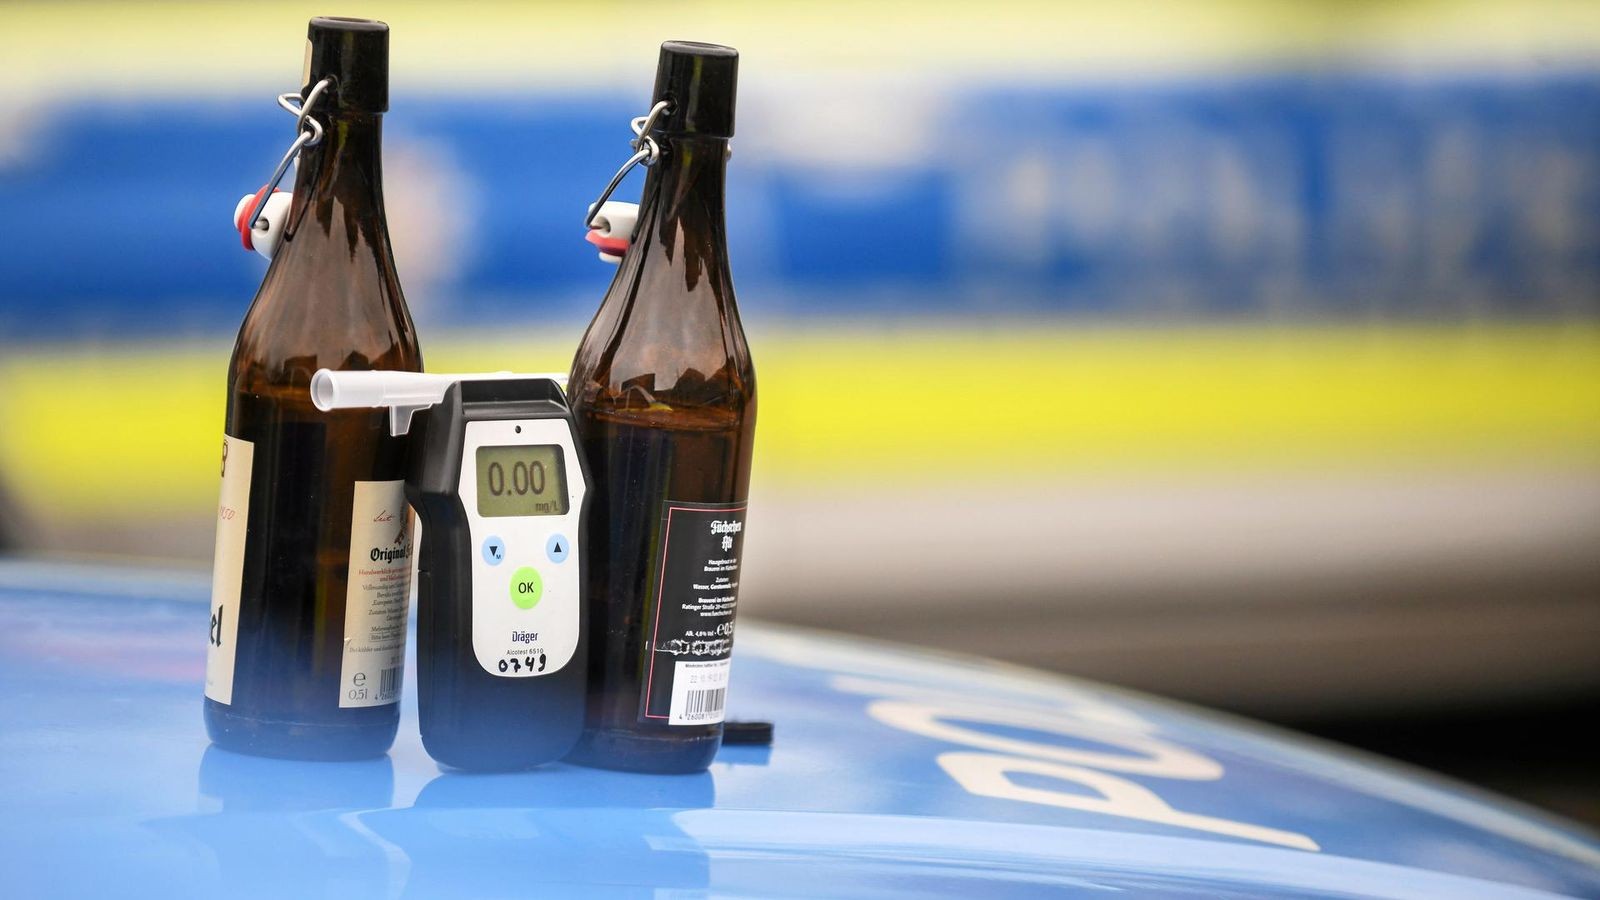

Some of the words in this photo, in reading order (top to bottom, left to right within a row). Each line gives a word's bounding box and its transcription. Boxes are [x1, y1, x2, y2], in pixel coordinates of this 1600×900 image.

[488, 461, 546, 496] 0.00
[370, 546, 406, 564] Original
[518, 582, 534, 594] OK
[512, 631, 538, 644] Dräger
